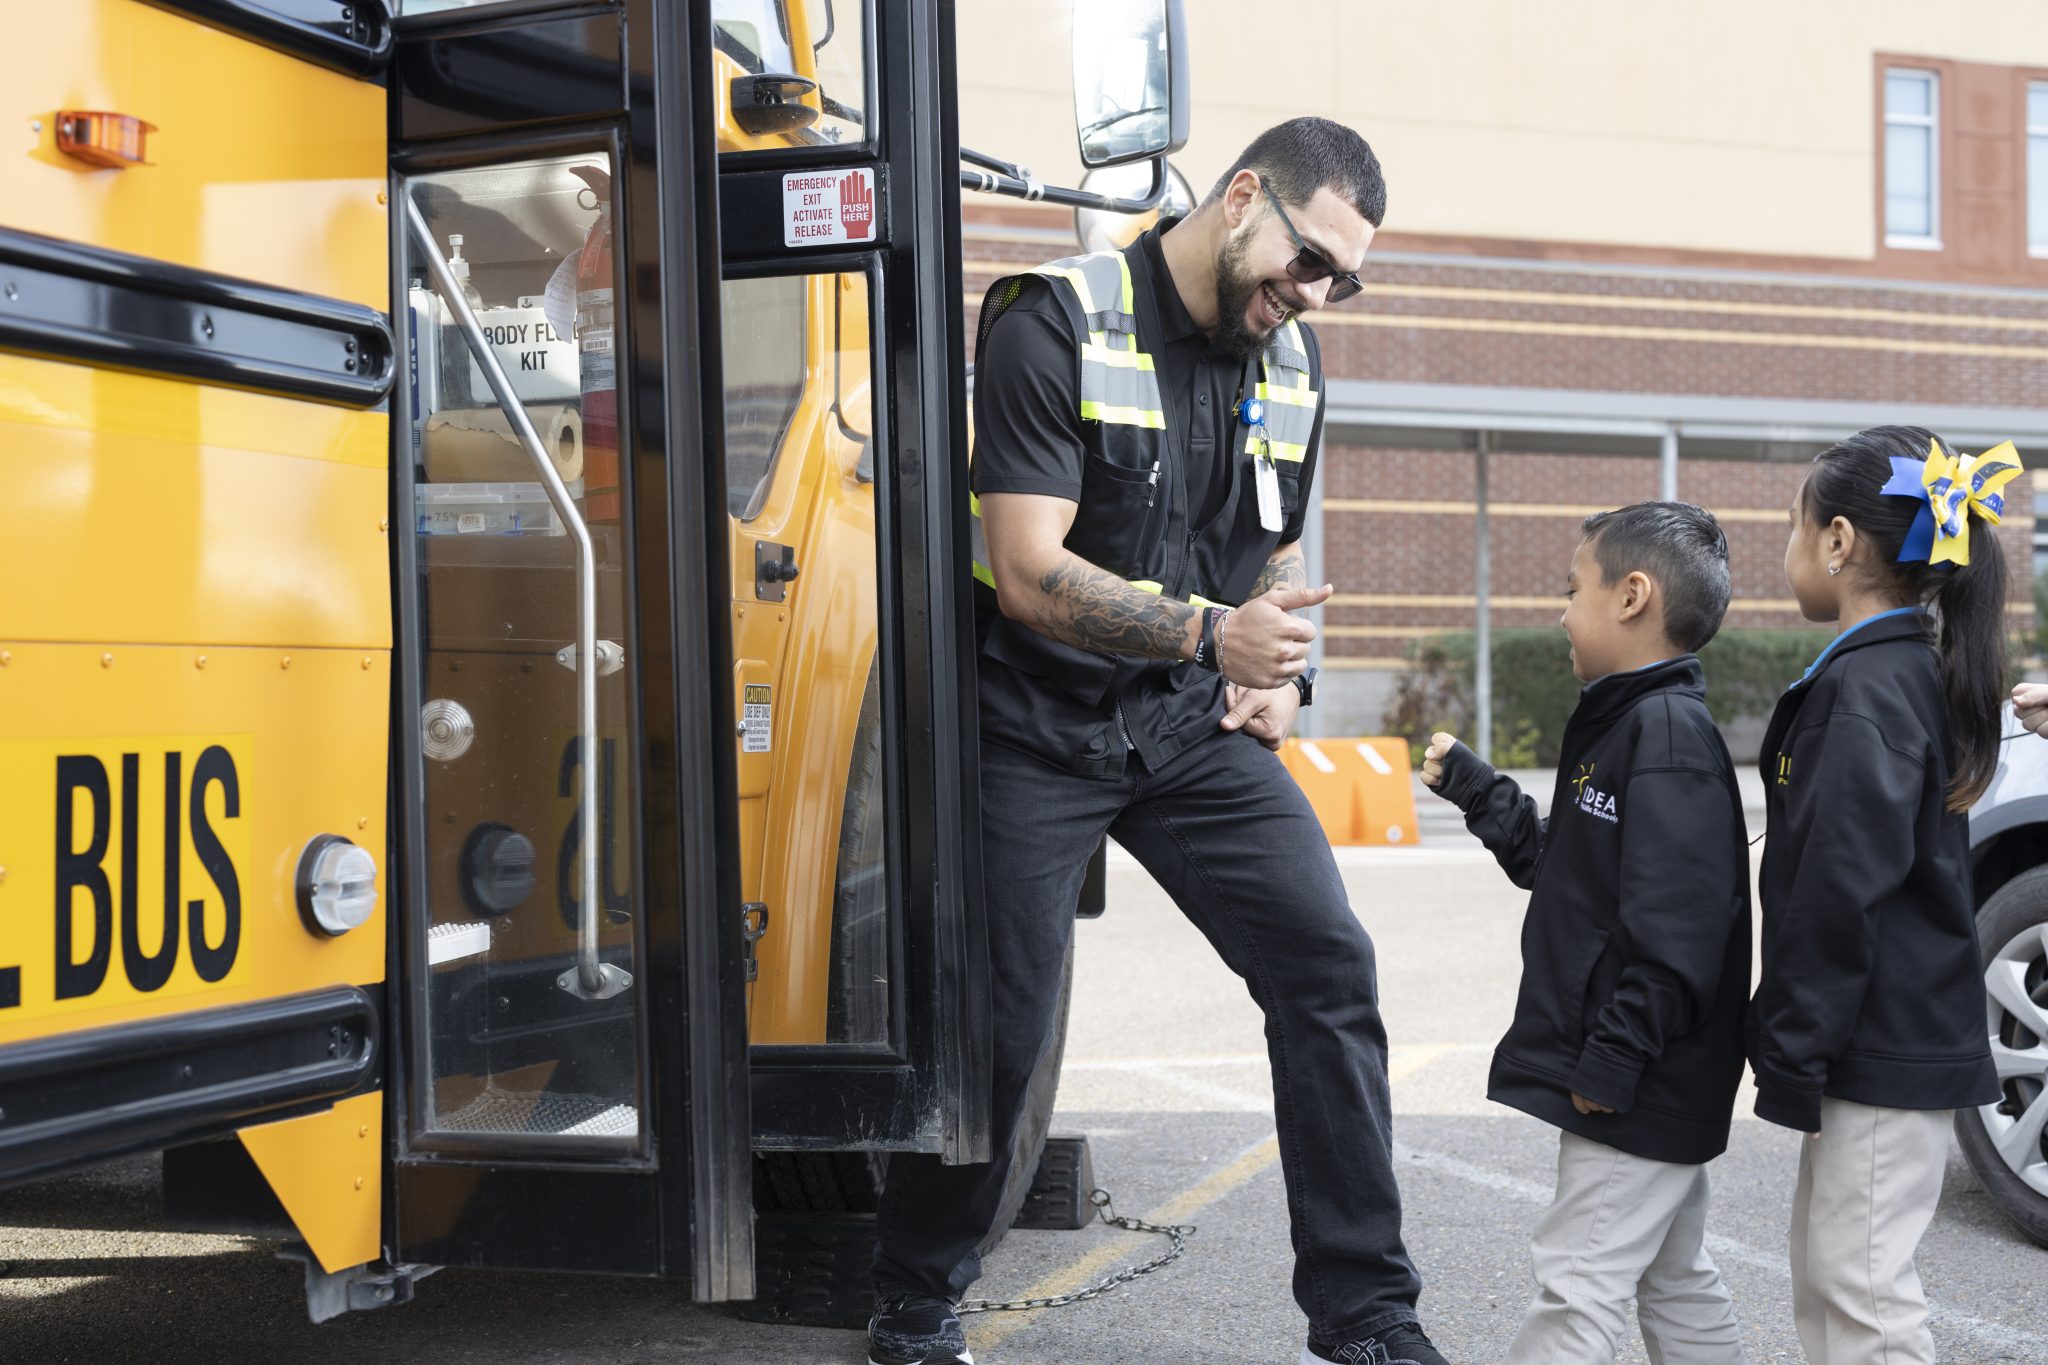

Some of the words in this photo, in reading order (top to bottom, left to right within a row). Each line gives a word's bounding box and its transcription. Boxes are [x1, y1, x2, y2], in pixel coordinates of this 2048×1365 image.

[787, 177, 837, 191] EMERGENCY
[803, 194, 822, 205] EXIT
[793, 208, 833, 222] ACTIVATE
[842, 203, 869, 213] PUSH
[843, 212, 870, 222] HERE
[795, 224, 833, 237] RELEASE
[483, 324, 529, 346] BODY
[521, 350, 548, 371] KIT
[746, 687, 771, 703] CAUTION
[1583, 785, 1616, 814] IDEA
[54, 745, 241, 1001] BUS
